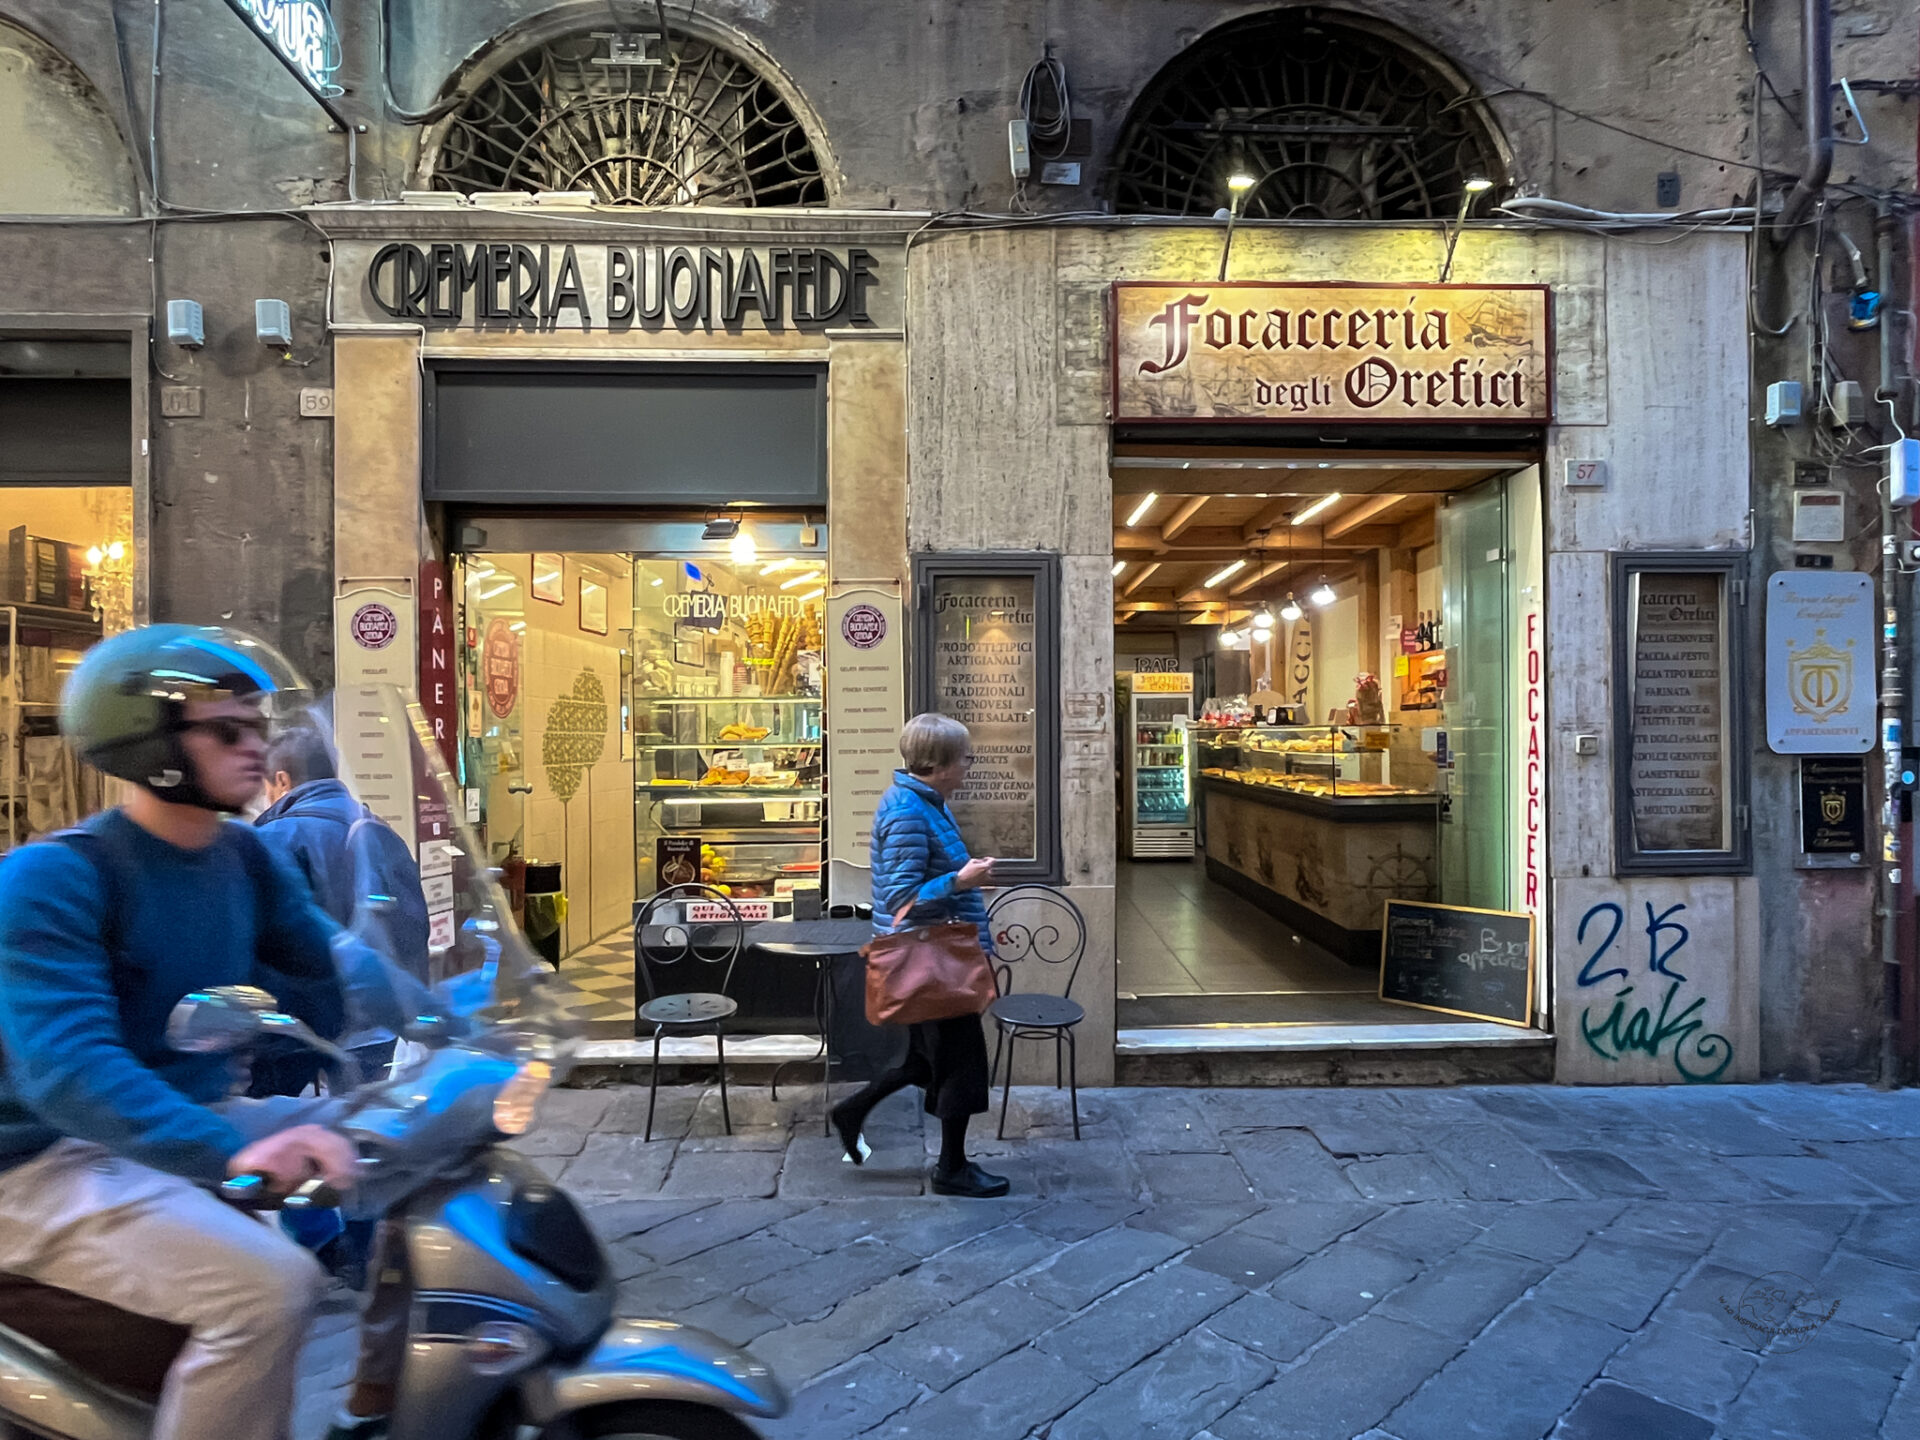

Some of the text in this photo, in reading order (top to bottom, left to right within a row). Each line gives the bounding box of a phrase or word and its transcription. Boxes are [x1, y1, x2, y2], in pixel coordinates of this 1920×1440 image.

[368, 242, 870, 321] CREMERIA BUONAFEDE
[1138, 293, 1452, 376] Focacceria
[1255, 355, 1526, 412] degli Orefici
[305, 395, 331, 411] 59
[1576, 463, 1597, 480] 57
[663, 594, 725, 619] CREMERIA
[431, 576, 446, 741] PÀNER
[947, 655, 1021, 667] ARTIGIANALI
[1135, 658, 1179, 673] BAR
[951, 672, 1017, 684] SPECIALITÀ
[943, 686, 1025, 697] TRADIZIONALI
[1645, 687, 1692, 697] FARINATA
[955, 699, 1012, 710] GENOVESI
[986, 713, 1028, 723] SALATE
[976, 745, 1033, 754] HOMEMADE
[972, 756, 1009, 765] ODUCTS
[1526, 613, 1540, 915] FOCACCER
[966, 771, 1015, 780] ADITIONAL
[720, 904, 768, 912] GLATO
